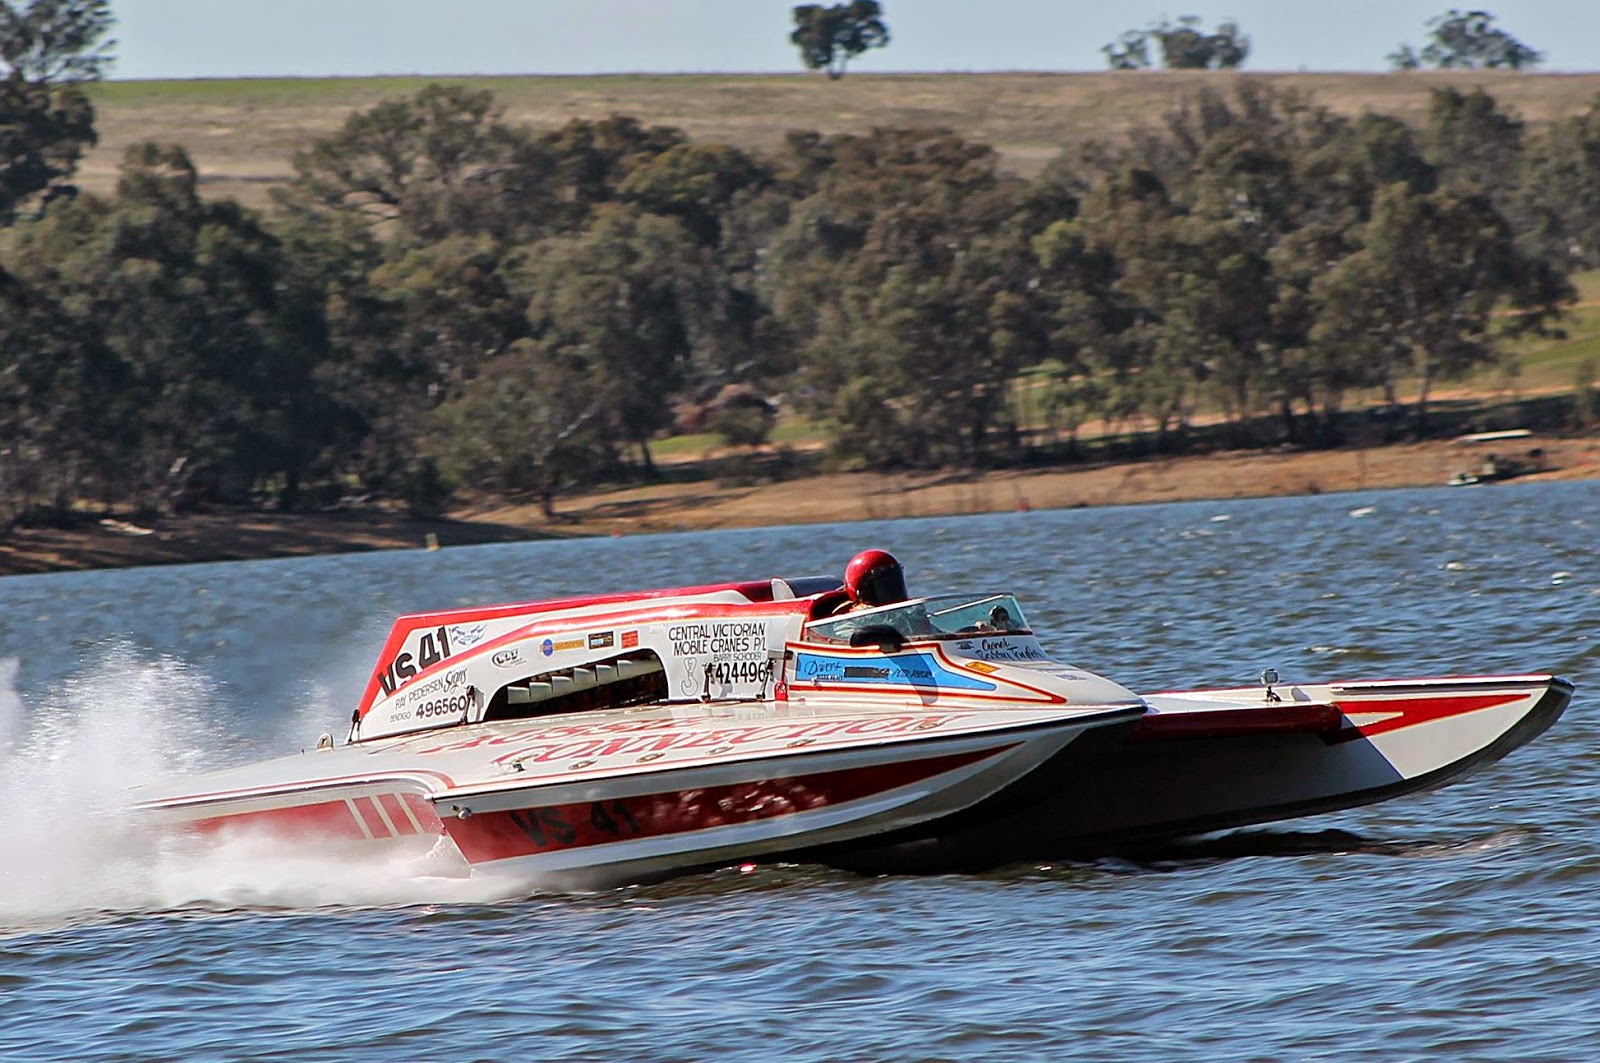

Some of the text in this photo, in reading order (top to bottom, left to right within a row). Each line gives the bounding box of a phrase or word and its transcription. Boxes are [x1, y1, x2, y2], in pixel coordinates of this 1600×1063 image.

[668, 622, 766, 641] CENTRAL VICTORIAN
[673, 639, 708, 656] MOBILE
[710, 637, 749, 653] CRANES
[713, 653, 732, 663] BARRY
[377, 652, 417, 697] VS
[418, 625, 451, 670] 41
[715, 662, 766, 685] 424496
[395, 667, 468, 711] RAY PEDERSEN Signs
[389, 695, 466, 723] BENDIGO 496560
[492, 713, 974, 767] CONNECTION
[508, 799, 641, 847] VS 41
